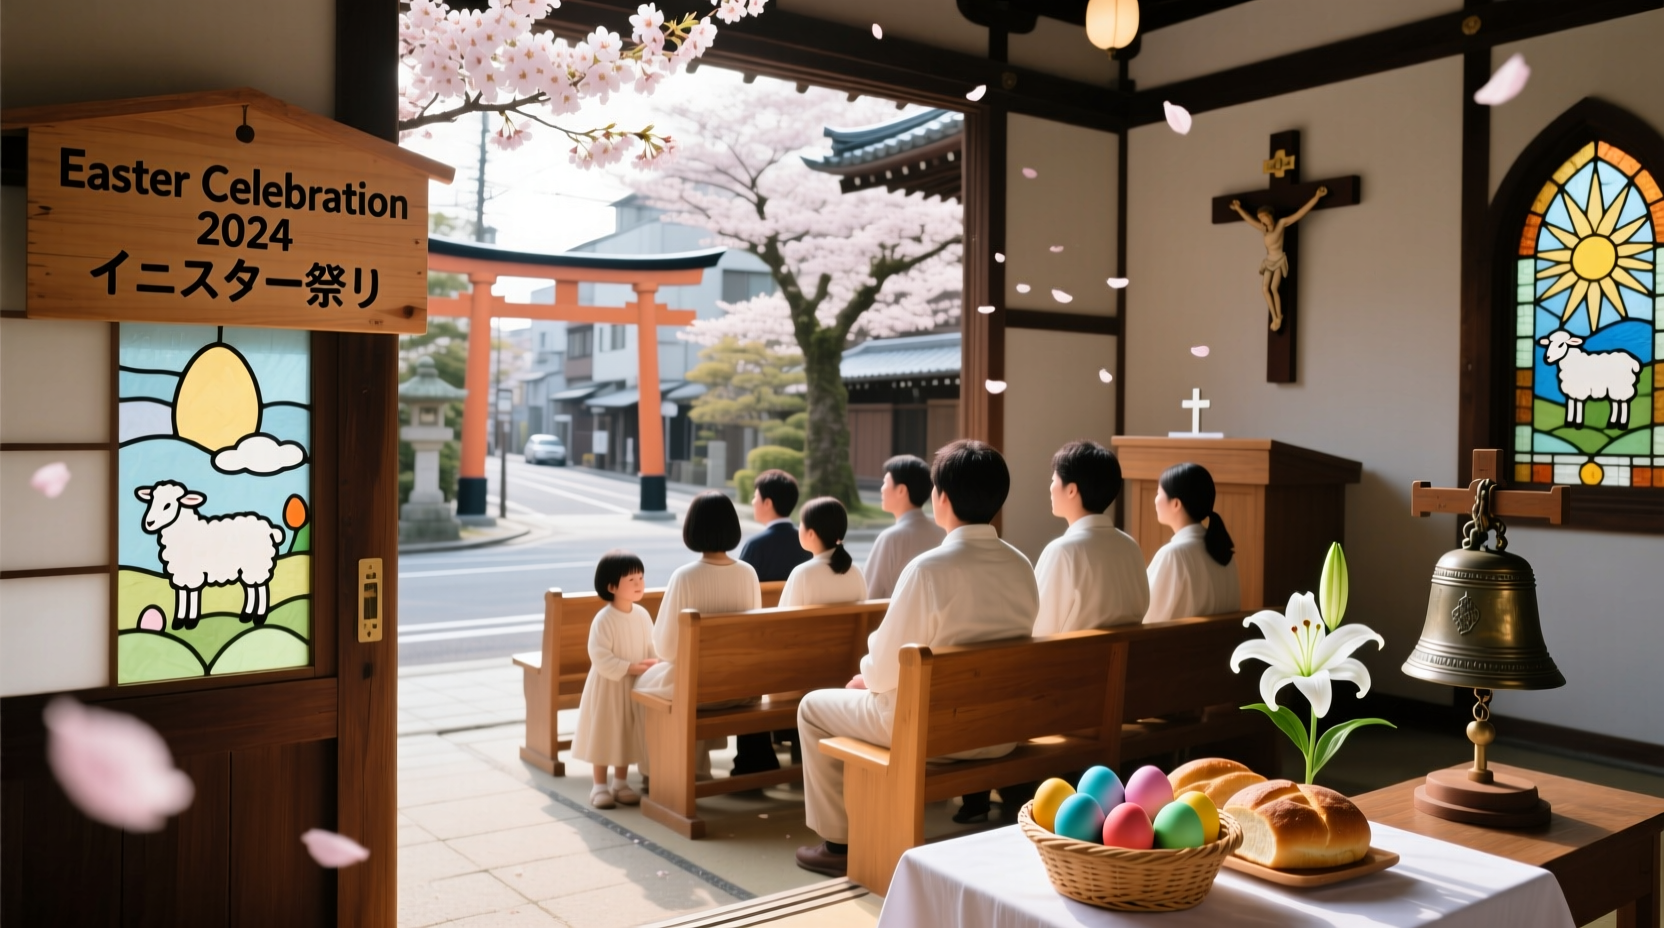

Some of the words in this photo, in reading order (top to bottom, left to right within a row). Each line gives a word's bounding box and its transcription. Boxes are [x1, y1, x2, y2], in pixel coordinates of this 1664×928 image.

[59, 146, 191, 198] Easter
[201, 164, 409, 220] Celebration
[196, 210, 294, 252] 2024
